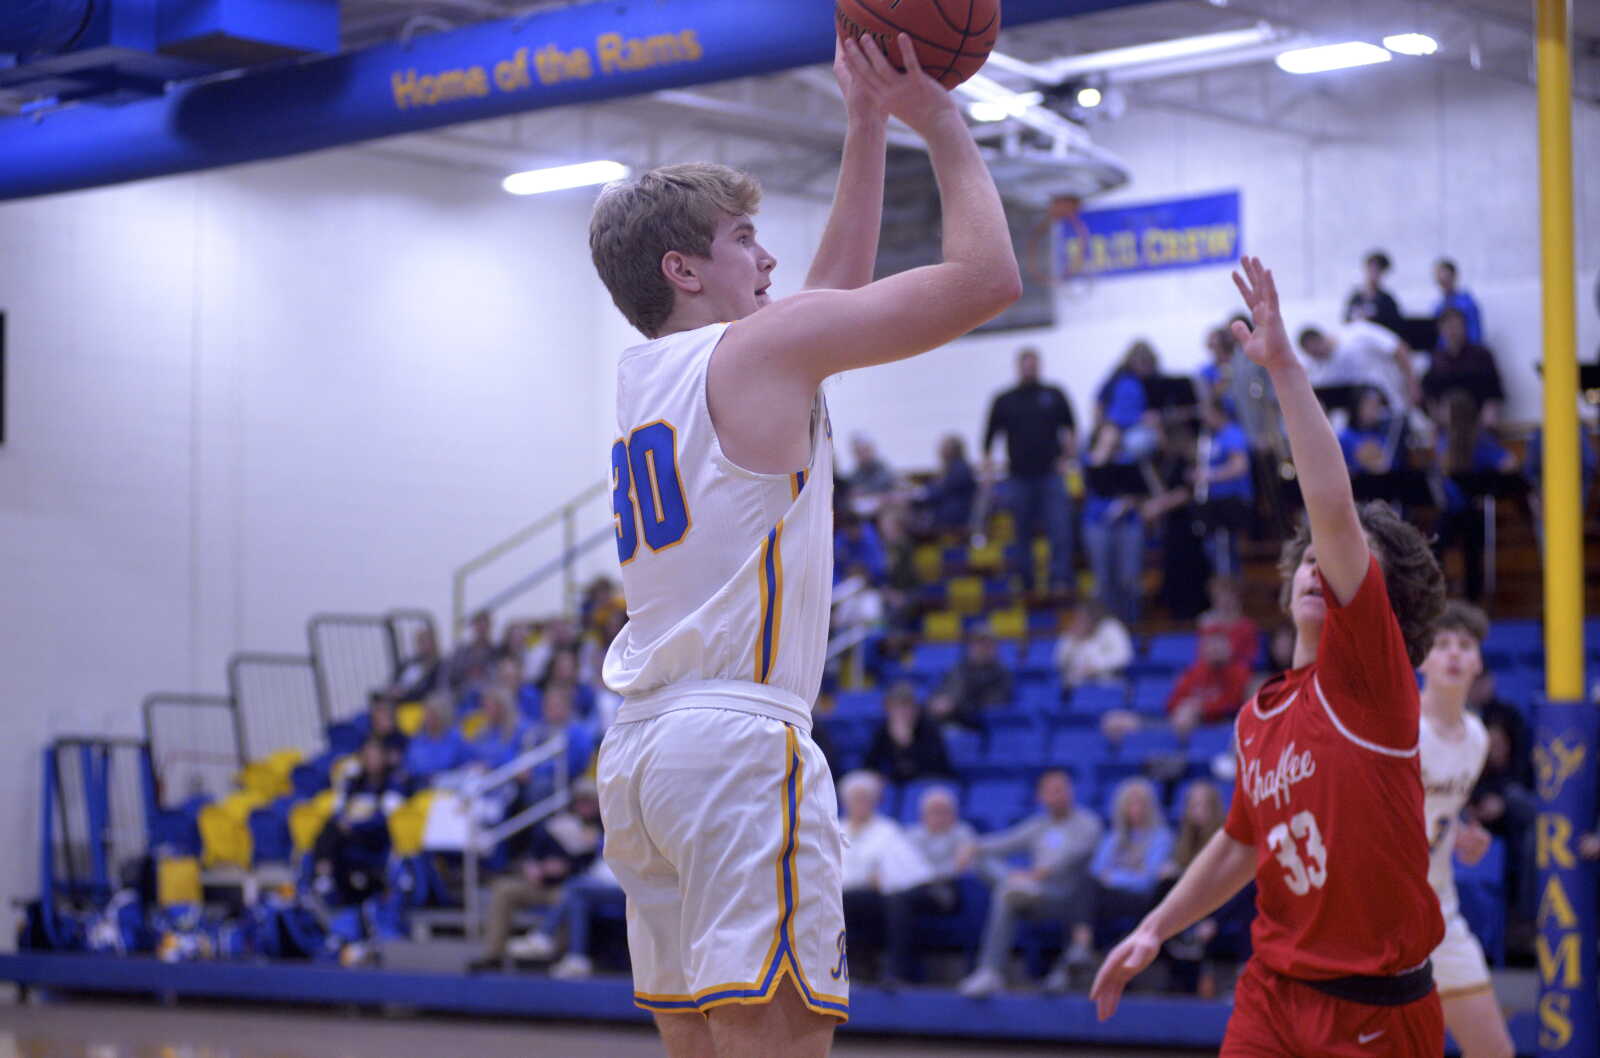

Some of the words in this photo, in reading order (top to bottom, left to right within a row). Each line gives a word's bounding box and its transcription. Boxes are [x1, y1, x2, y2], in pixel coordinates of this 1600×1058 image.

[391, 66, 489, 110] Home
[494, 47, 530, 91] of
[534, 44, 593, 85] the
[597, 29, 702, 73] Rams
[611, 418, 693, 567] 30
[1267, 810, 1328, 896] 33
[1535, 811, 1583, 1050] RAMS
